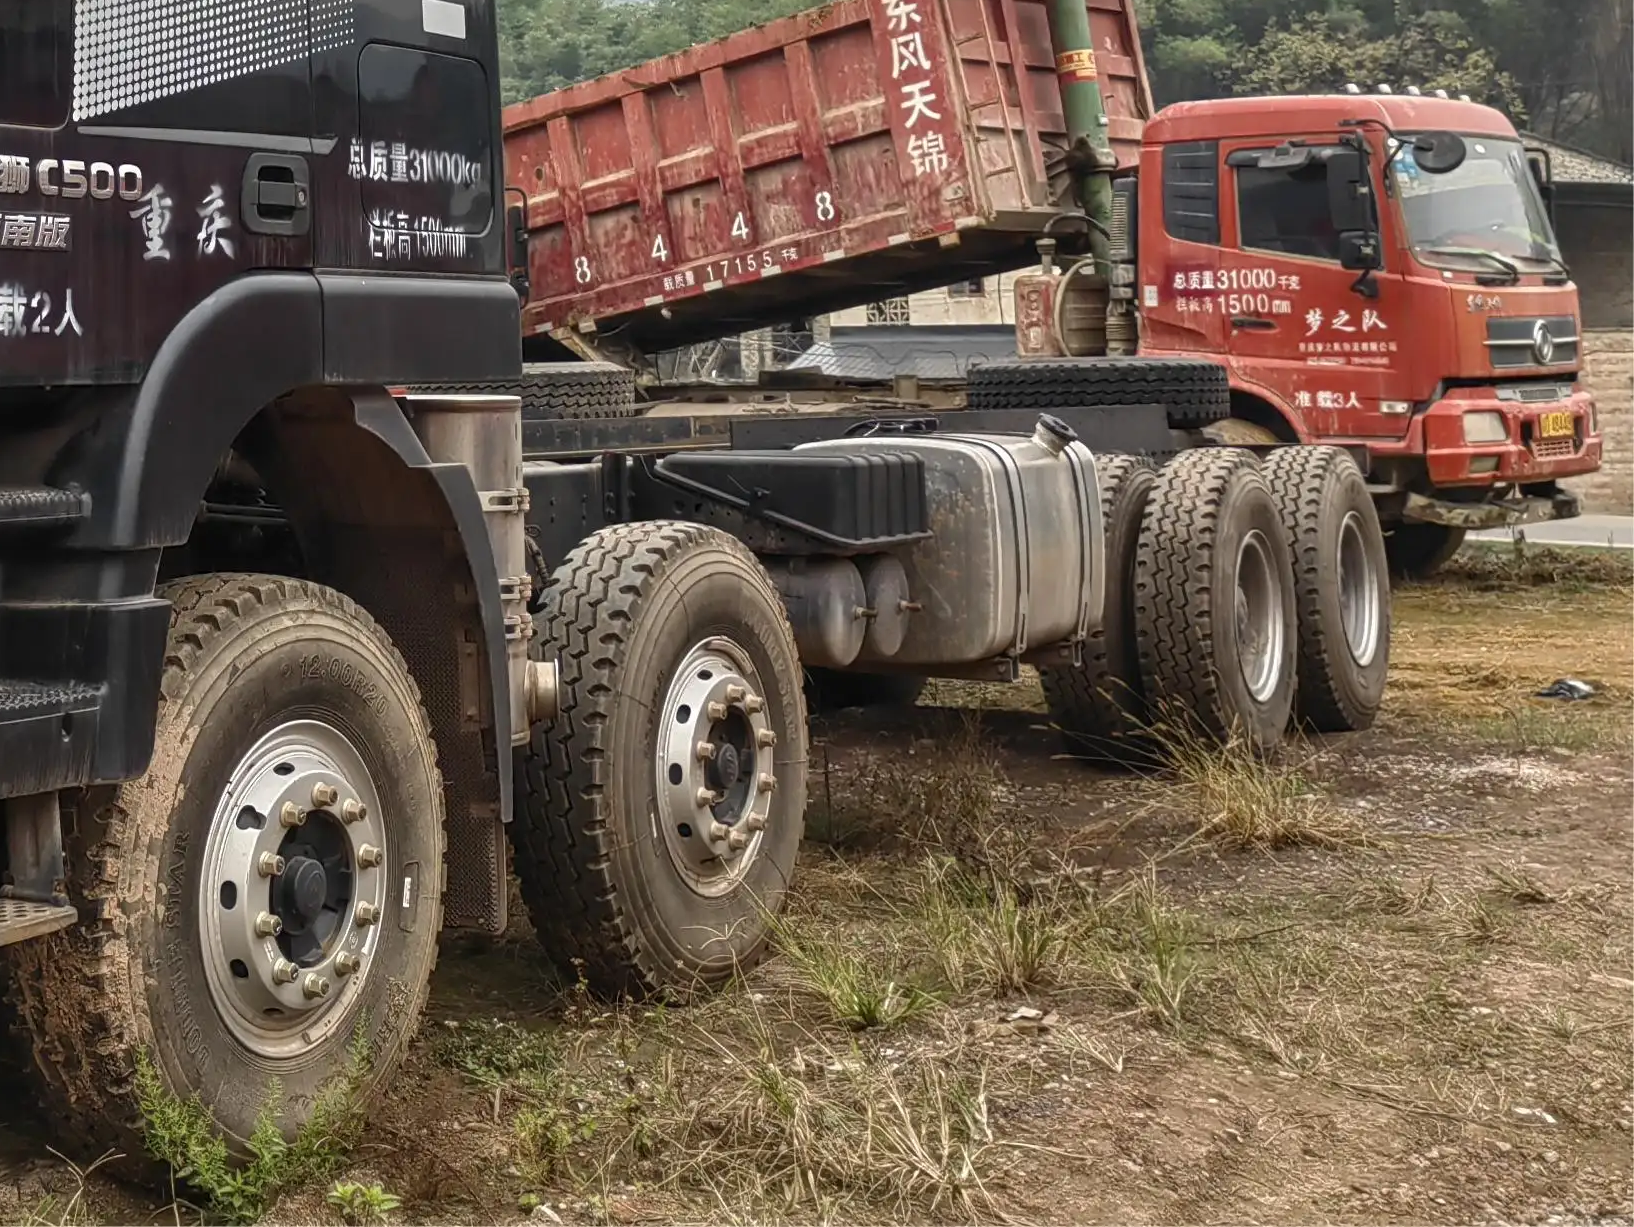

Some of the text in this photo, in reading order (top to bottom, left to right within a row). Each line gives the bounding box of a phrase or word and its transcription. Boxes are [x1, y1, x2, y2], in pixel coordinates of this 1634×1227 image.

[36, 158, 143, 201] C500
[707, 250, 773, 282] 17155
[1304, 307, 1388, 337] 梦之队
[298, 653, 390, 717] 12.00R20
[164, 830, 191, 930] STAR
